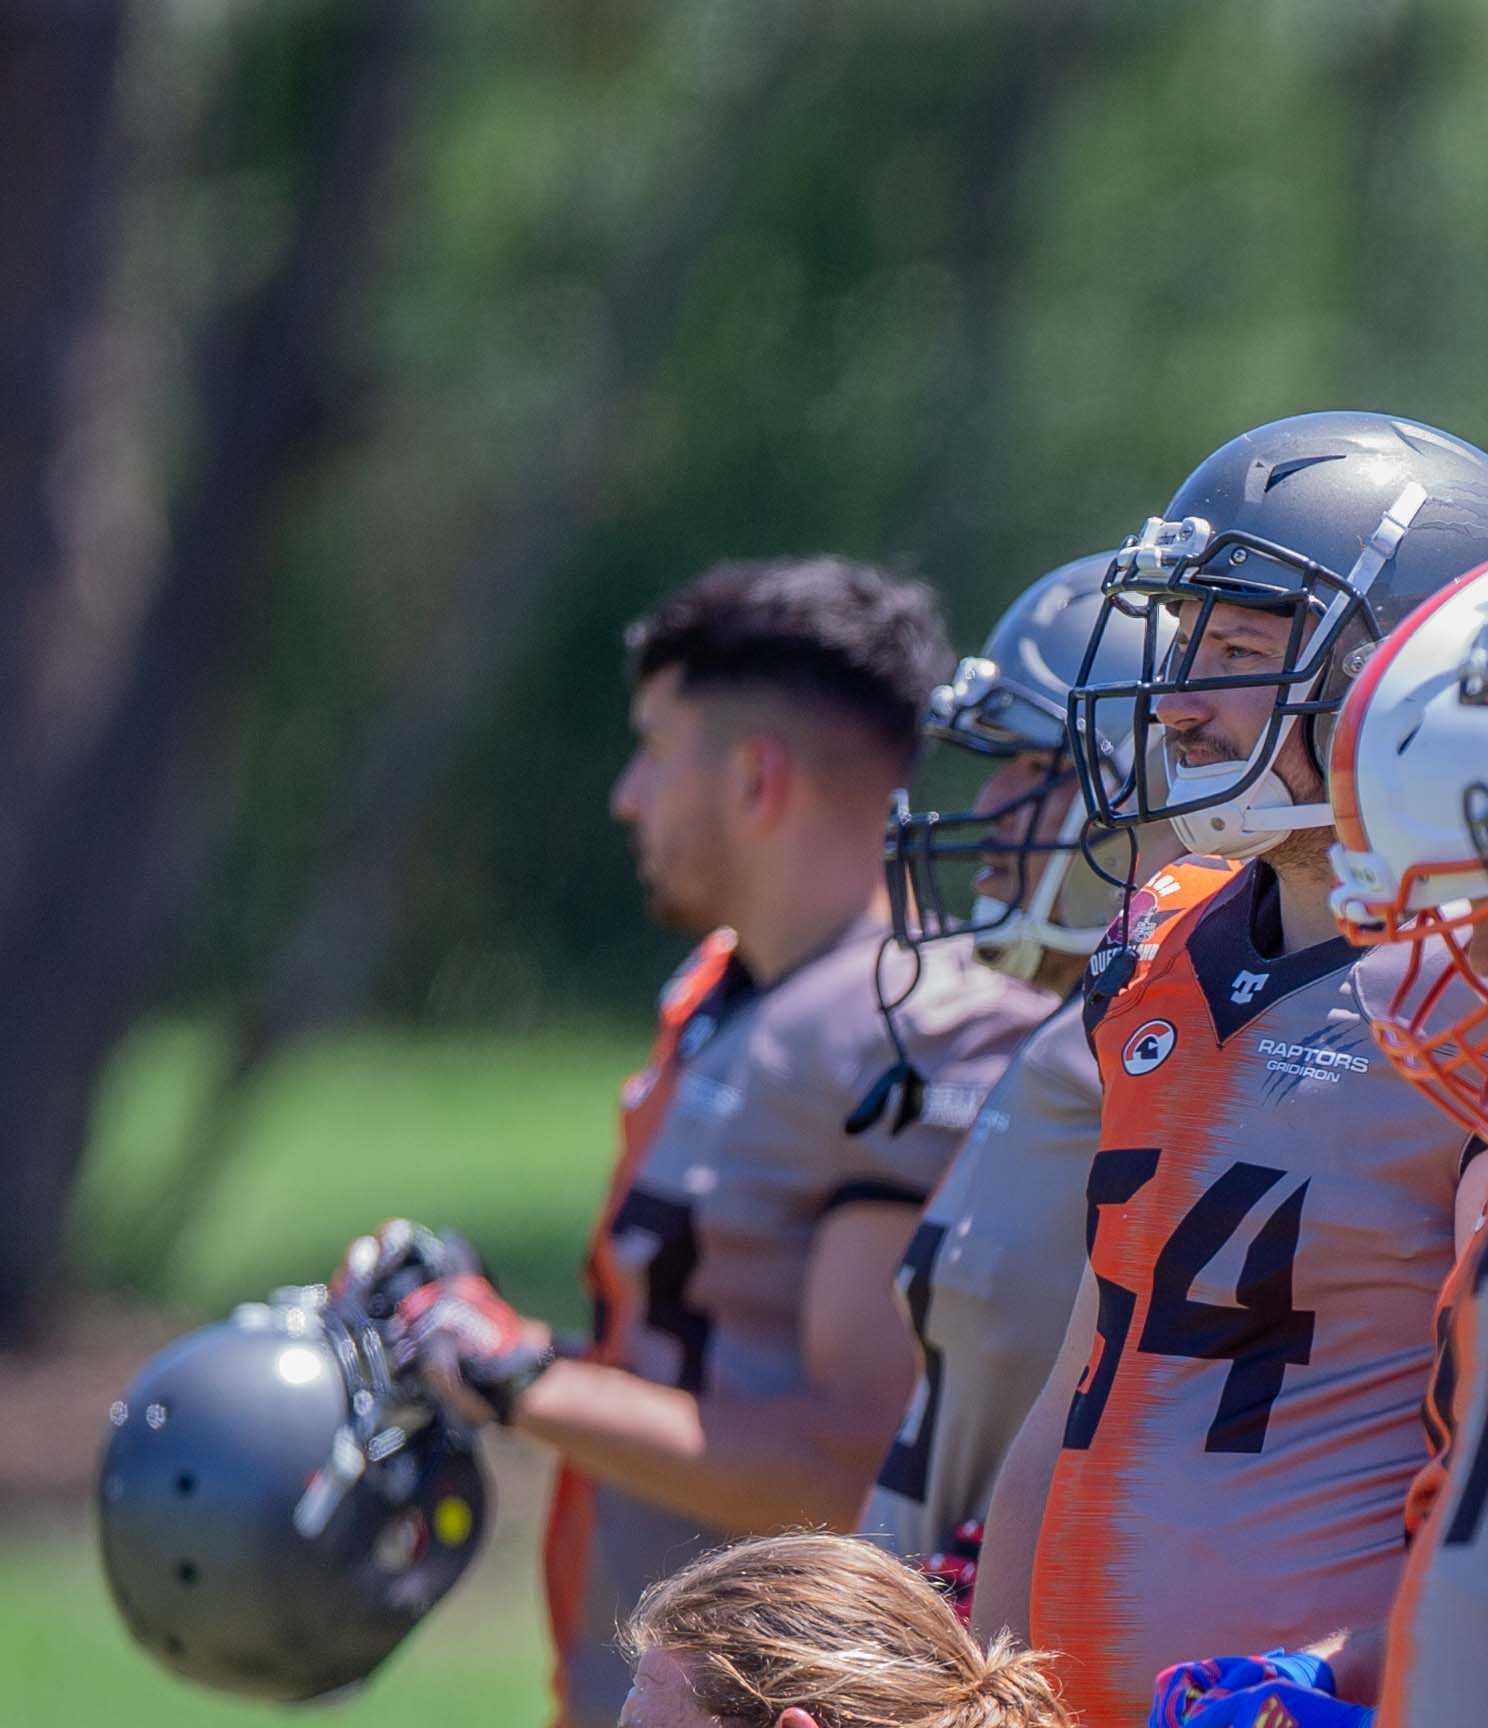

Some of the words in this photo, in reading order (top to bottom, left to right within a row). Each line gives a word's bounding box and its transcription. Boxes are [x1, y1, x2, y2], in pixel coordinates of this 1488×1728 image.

[1258, 1039, 1369, 1073] RAPTORS
[1266, 1060, 1340, 1082] GRIDIRON
[1062, 1147, 1316, 1453] 54
